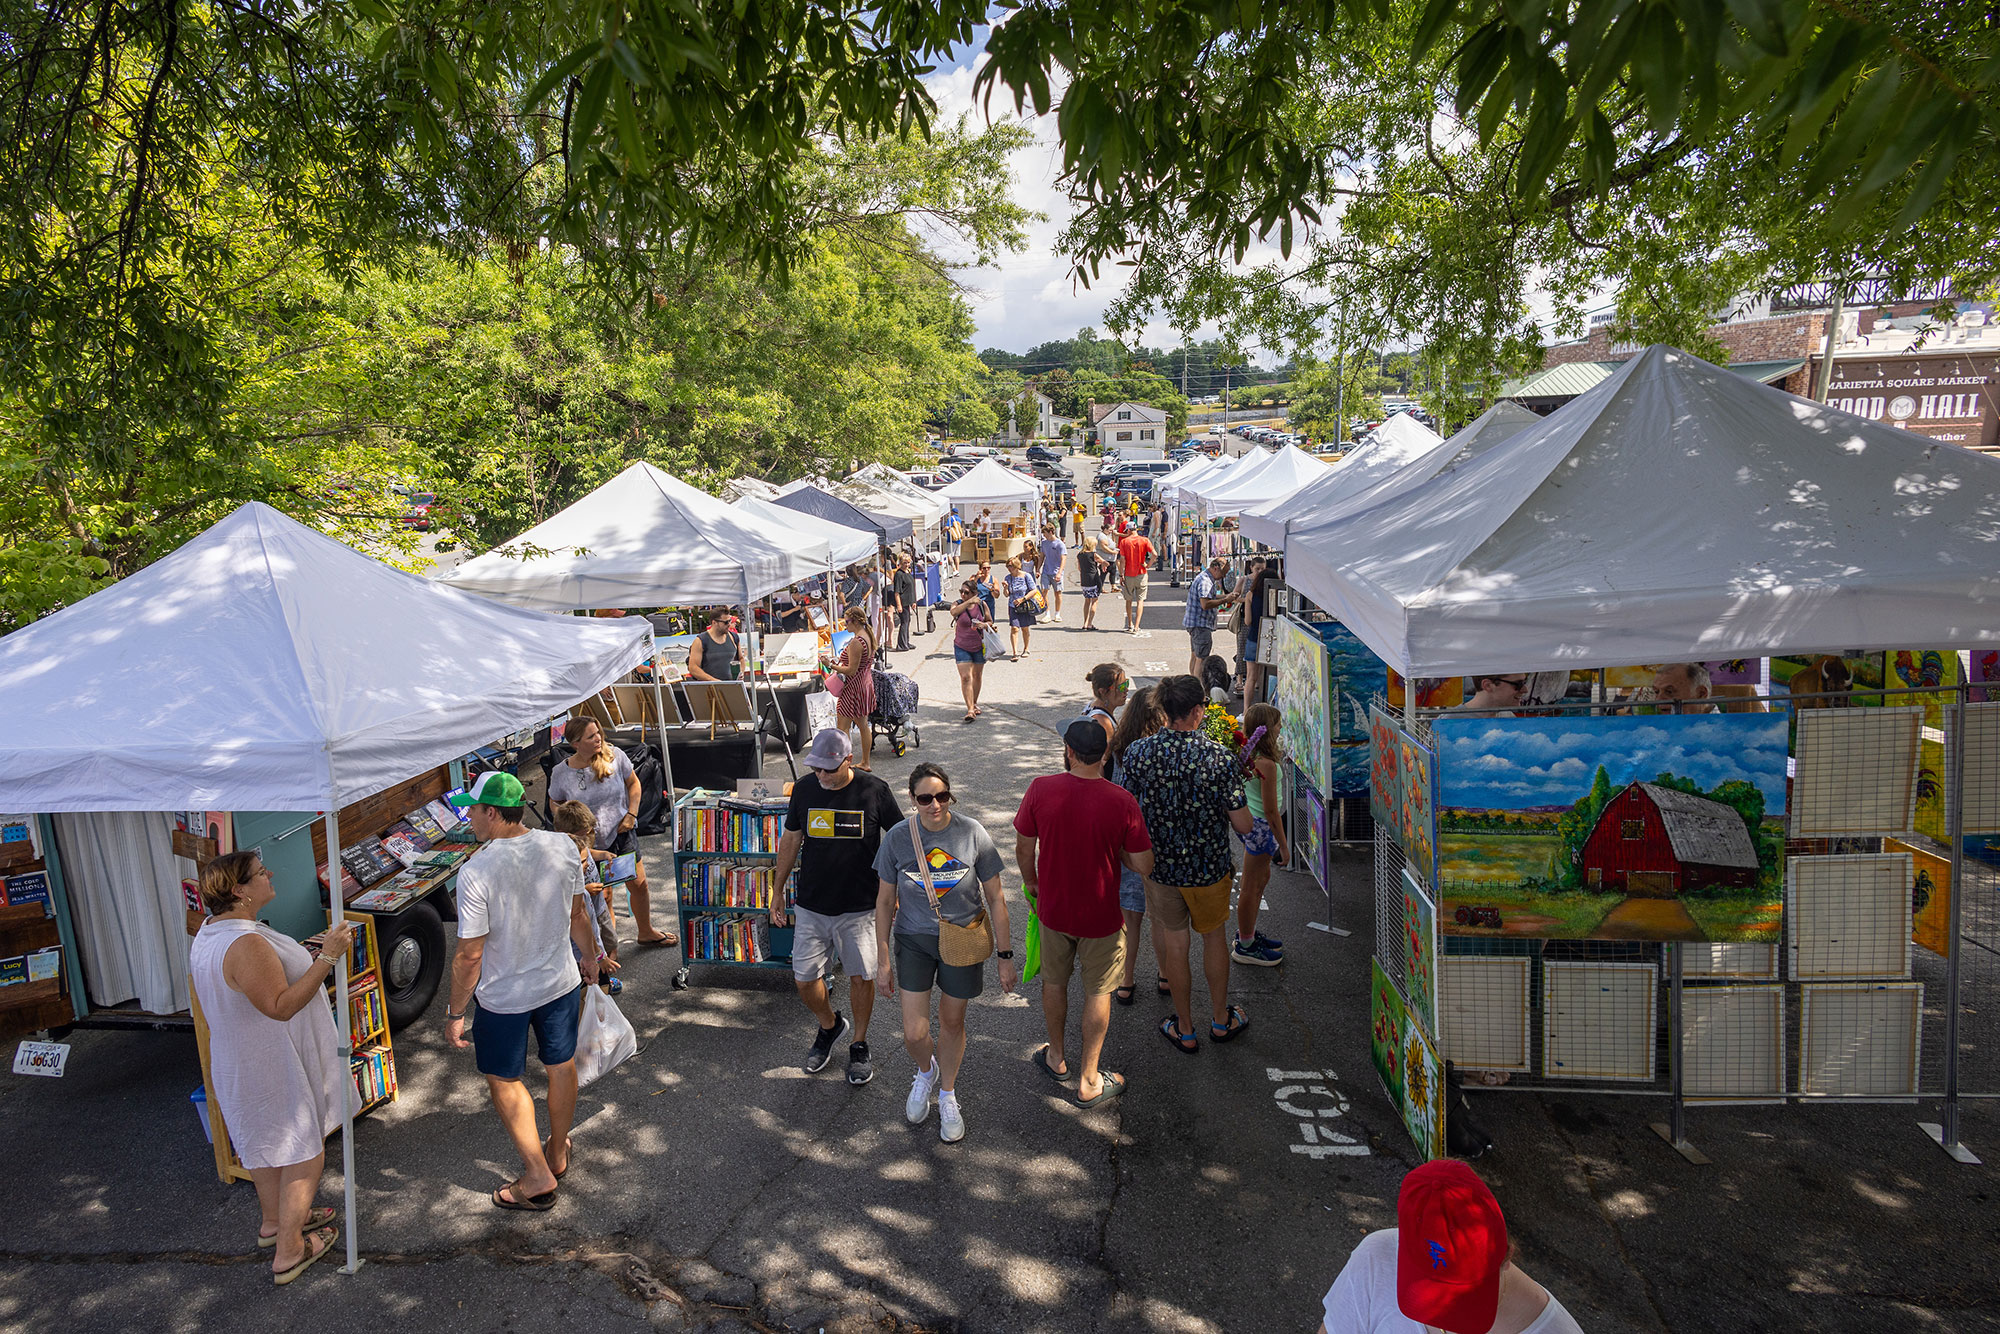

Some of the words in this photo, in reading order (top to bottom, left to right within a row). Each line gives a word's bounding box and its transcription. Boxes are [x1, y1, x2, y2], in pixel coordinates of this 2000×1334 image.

[1828, 379, 1884, 390] MARIETTA
[1886, 378, 1935, 388] SQUARE
[1937, 376, 1988, 386] MARKET
[1917, 393, 1980, 419] HALL
[9, 883, 45, 893] MILLIONS
[3, 962, 22, 970] Lucy
[1265, 1067, 1371, 1160] 104
